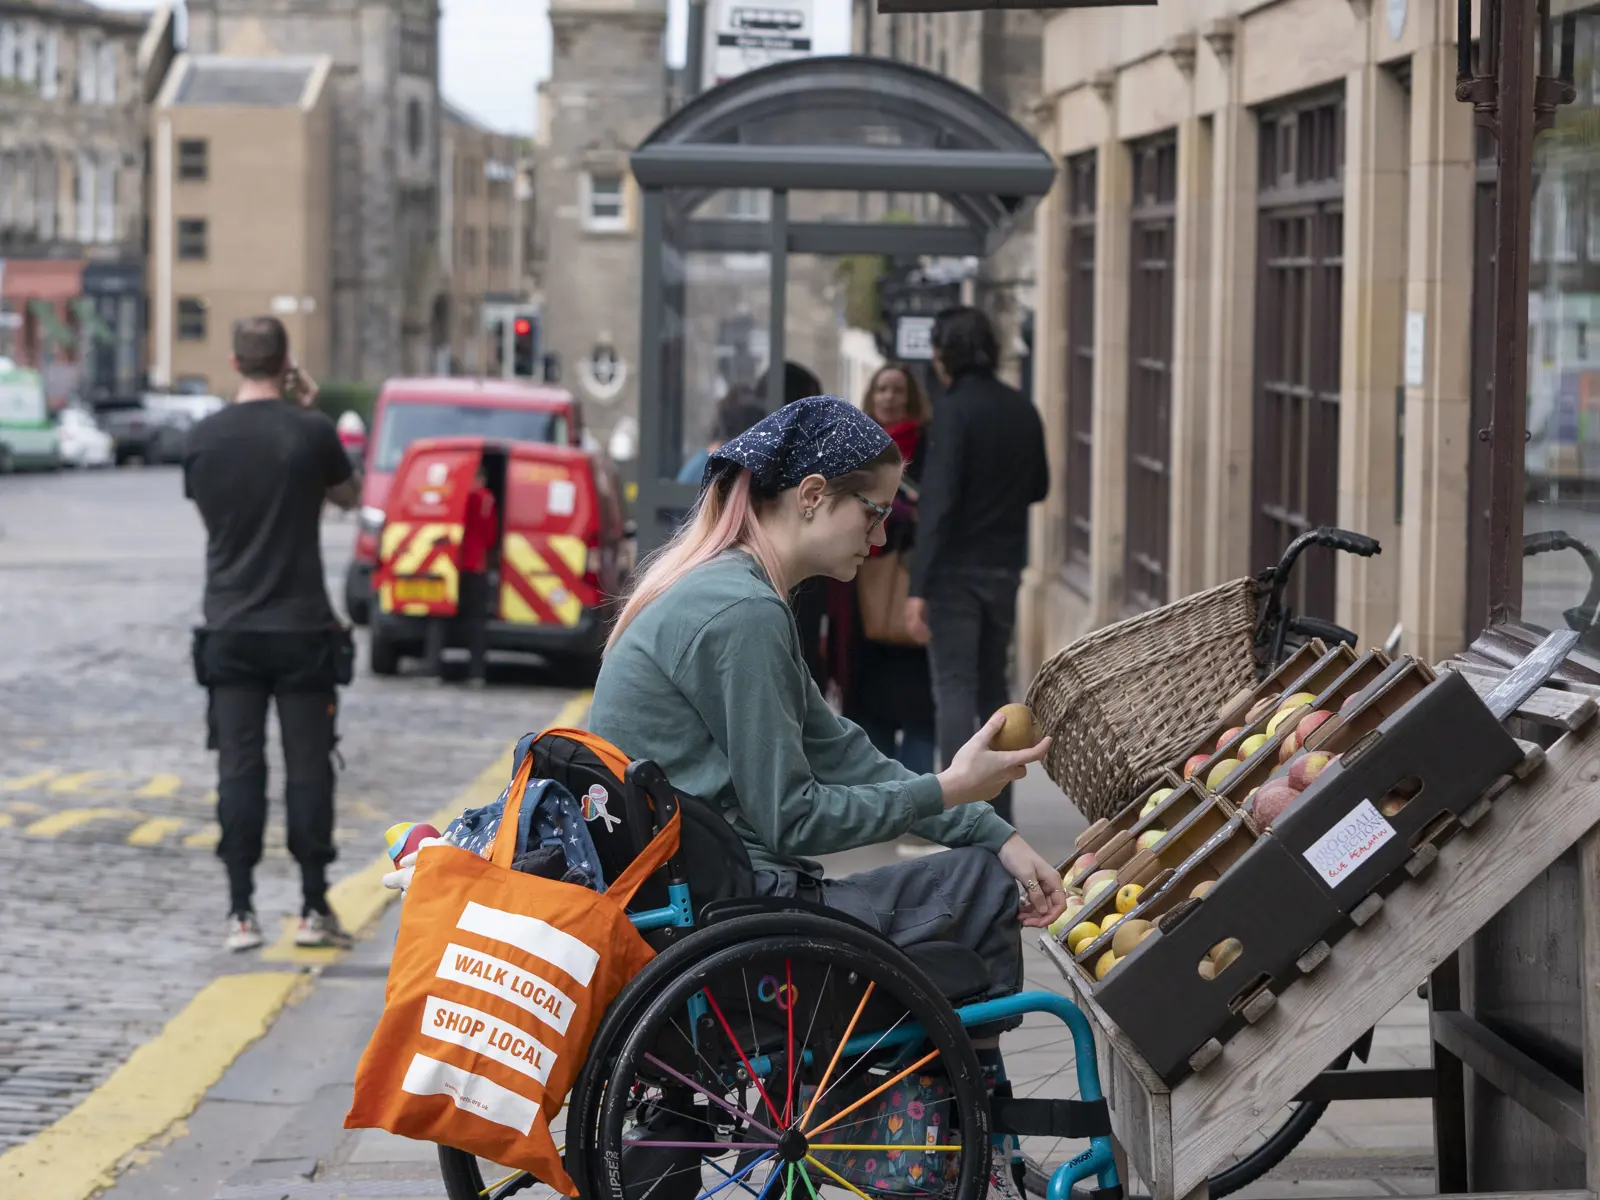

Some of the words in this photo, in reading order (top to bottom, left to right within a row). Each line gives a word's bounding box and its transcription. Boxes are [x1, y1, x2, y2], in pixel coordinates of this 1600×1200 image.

[454, 953, 508, 986] WALK
[510, 975, 562, 1020] LOCAL
[433, 1007, 485, 1038] SHOP
[488, 1027, 542, 1070] LOCAL
